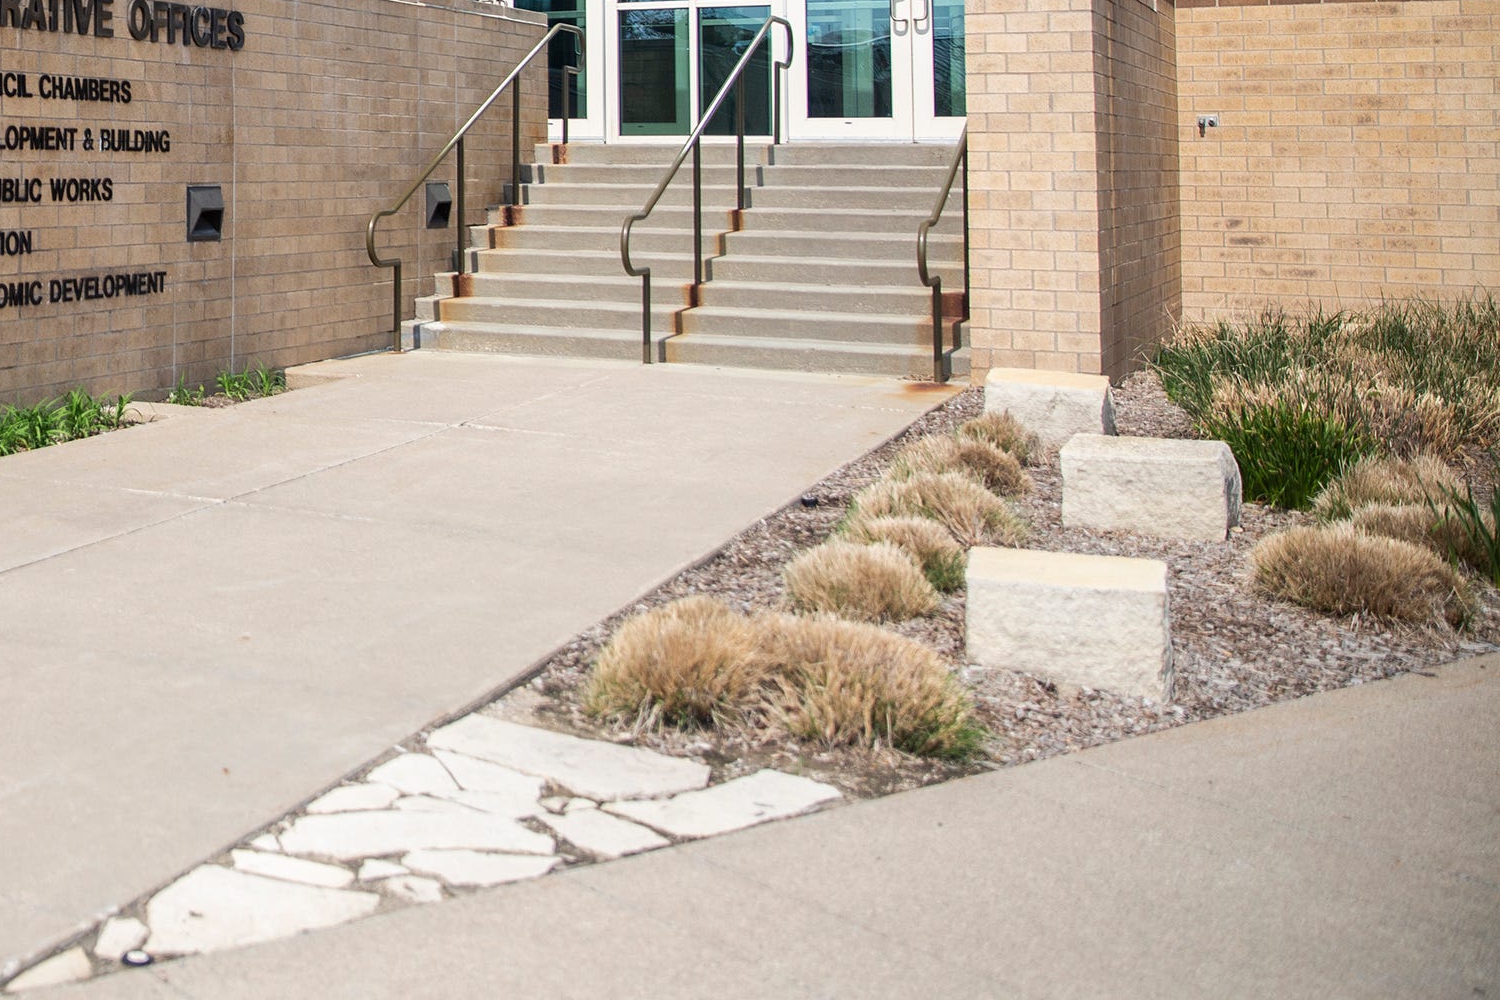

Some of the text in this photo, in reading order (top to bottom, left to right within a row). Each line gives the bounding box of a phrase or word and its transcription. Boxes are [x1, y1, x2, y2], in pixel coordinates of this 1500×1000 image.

[38, 74, 132, 103] CHAMBERS
[82, 128, 94, 151] &
[100, 129, 171, 153] BUILDING
[50, 178, 114, 202] WORKS
[50, 271, 167, 303] DEVELOPMENT
